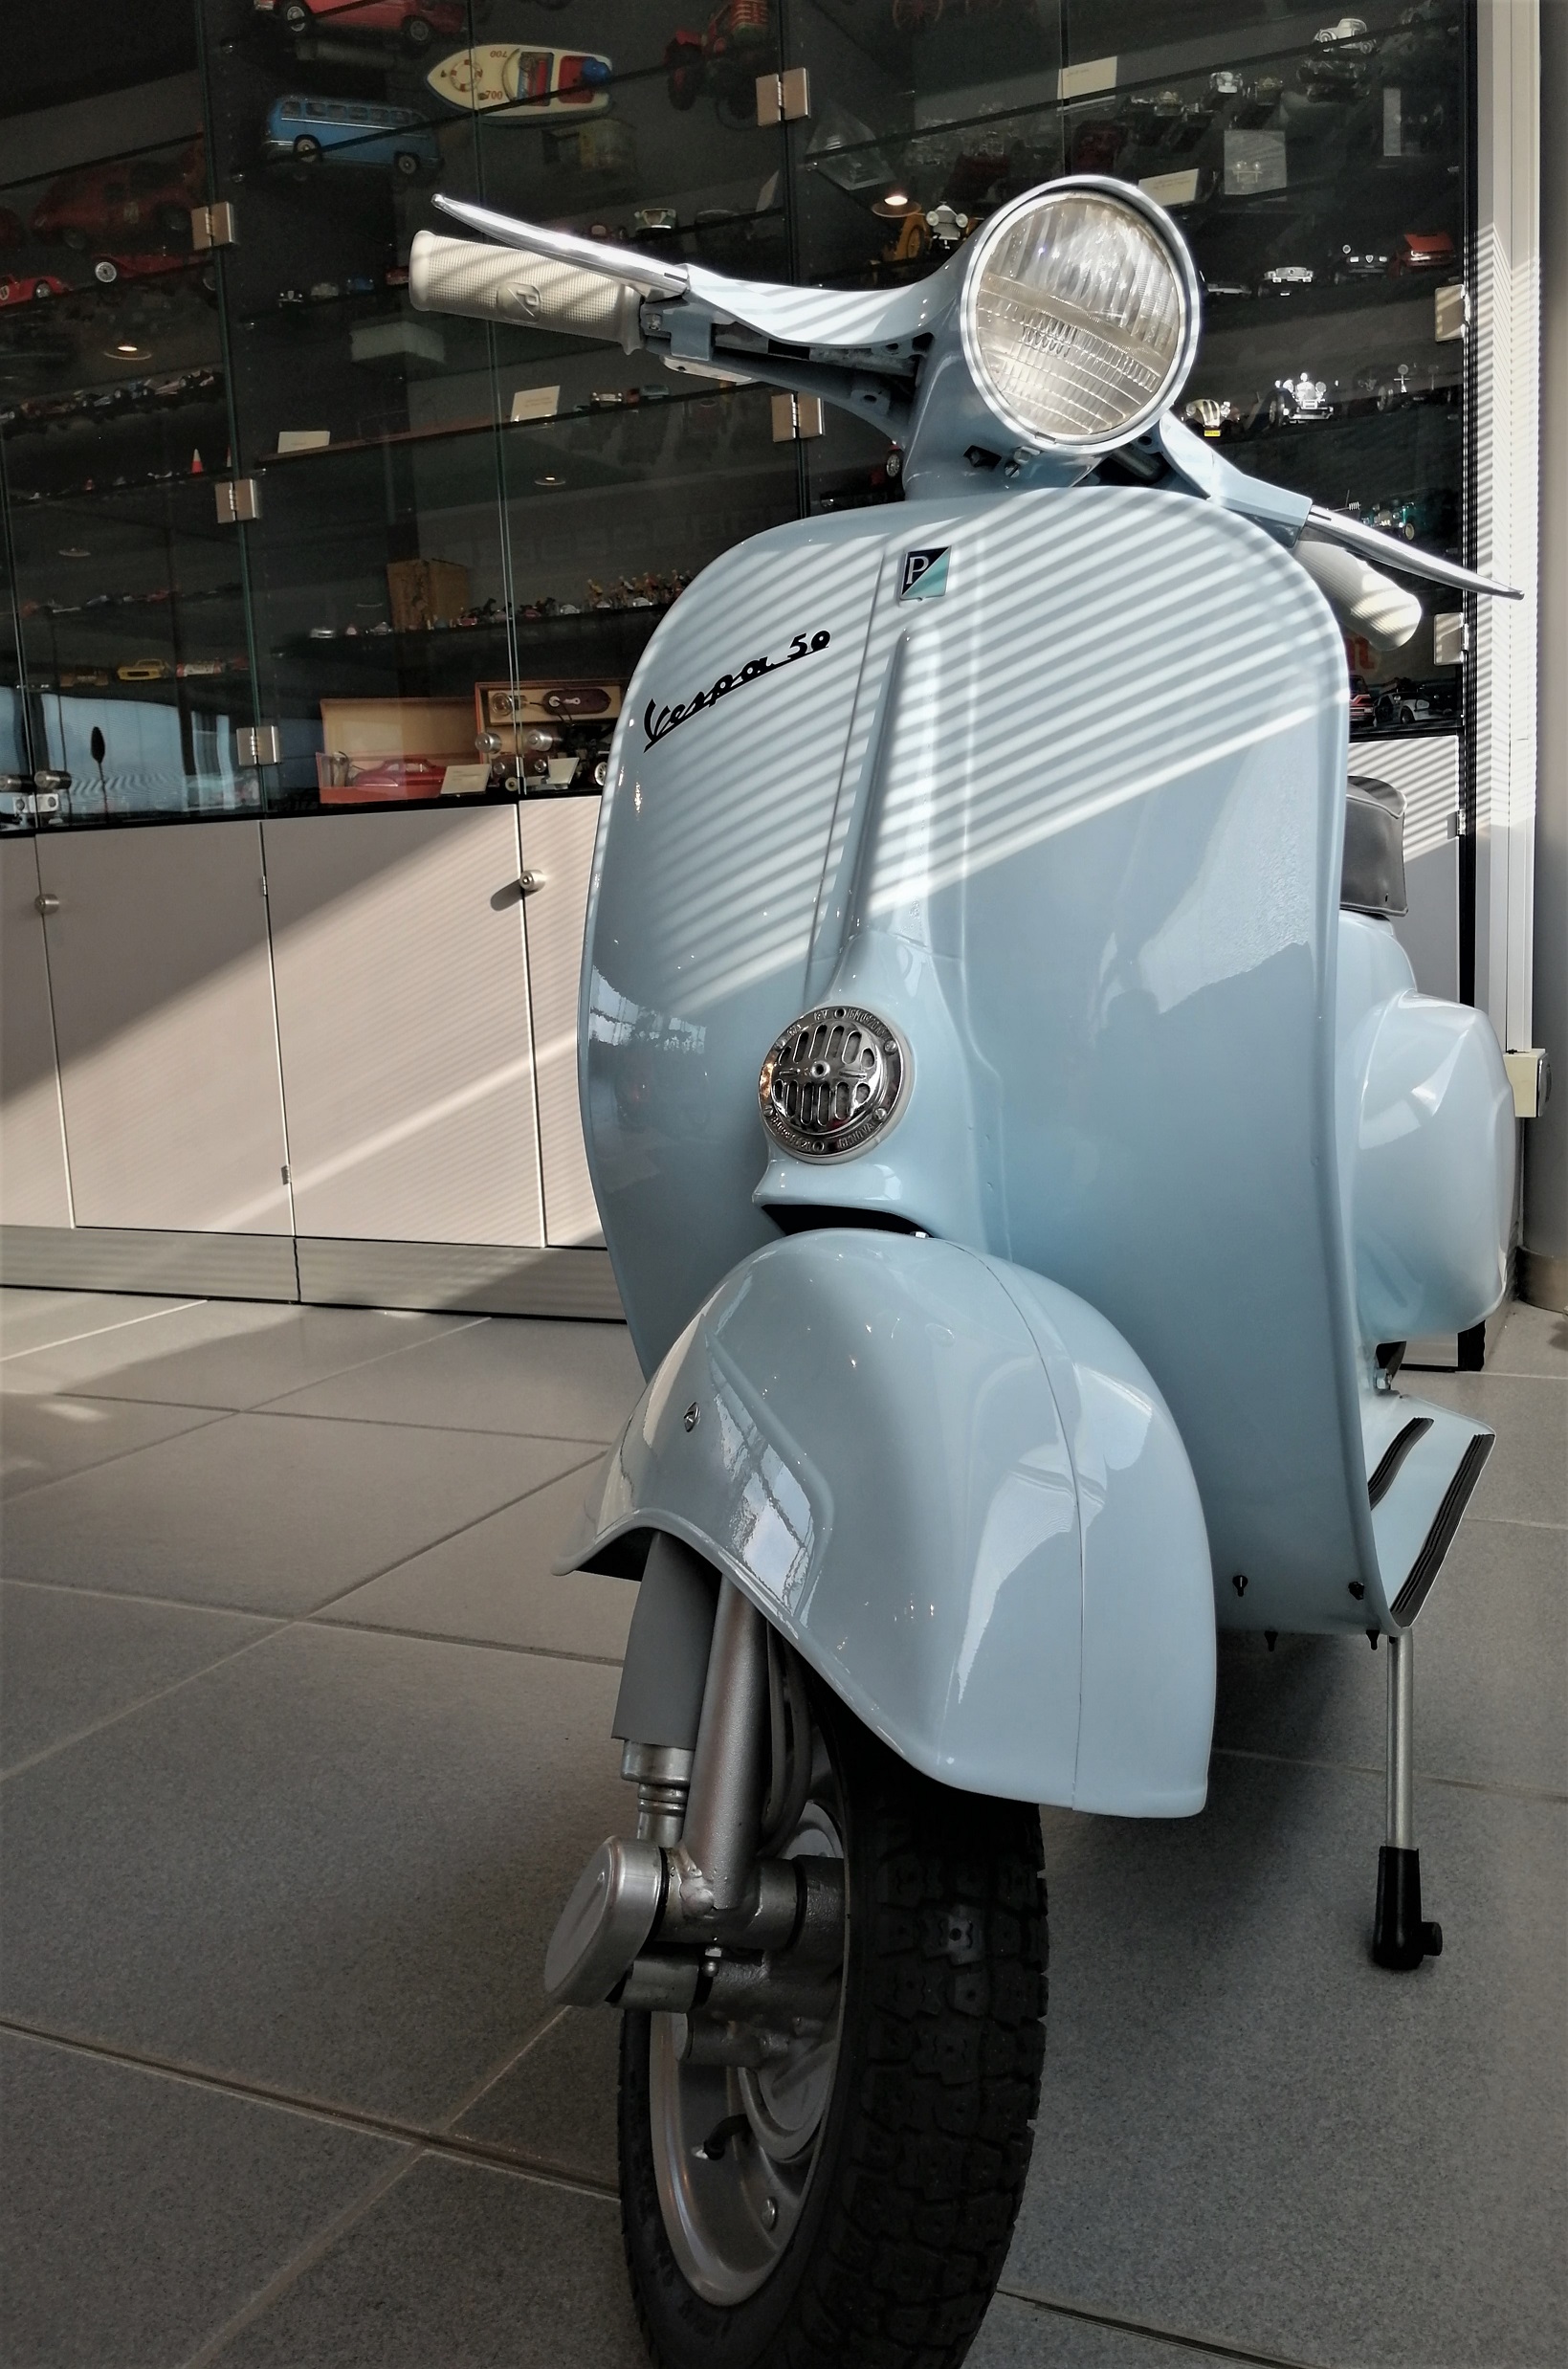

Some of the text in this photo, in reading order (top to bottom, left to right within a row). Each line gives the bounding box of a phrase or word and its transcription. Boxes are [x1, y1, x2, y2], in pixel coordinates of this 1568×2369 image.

[490, 50, 508, 58] 700
[485, 90, 503, 100] 700
[517, 289, 540, 306] P
[906, 556, 929, 585] P
[644, 630, 831, 753] Vespa 50
